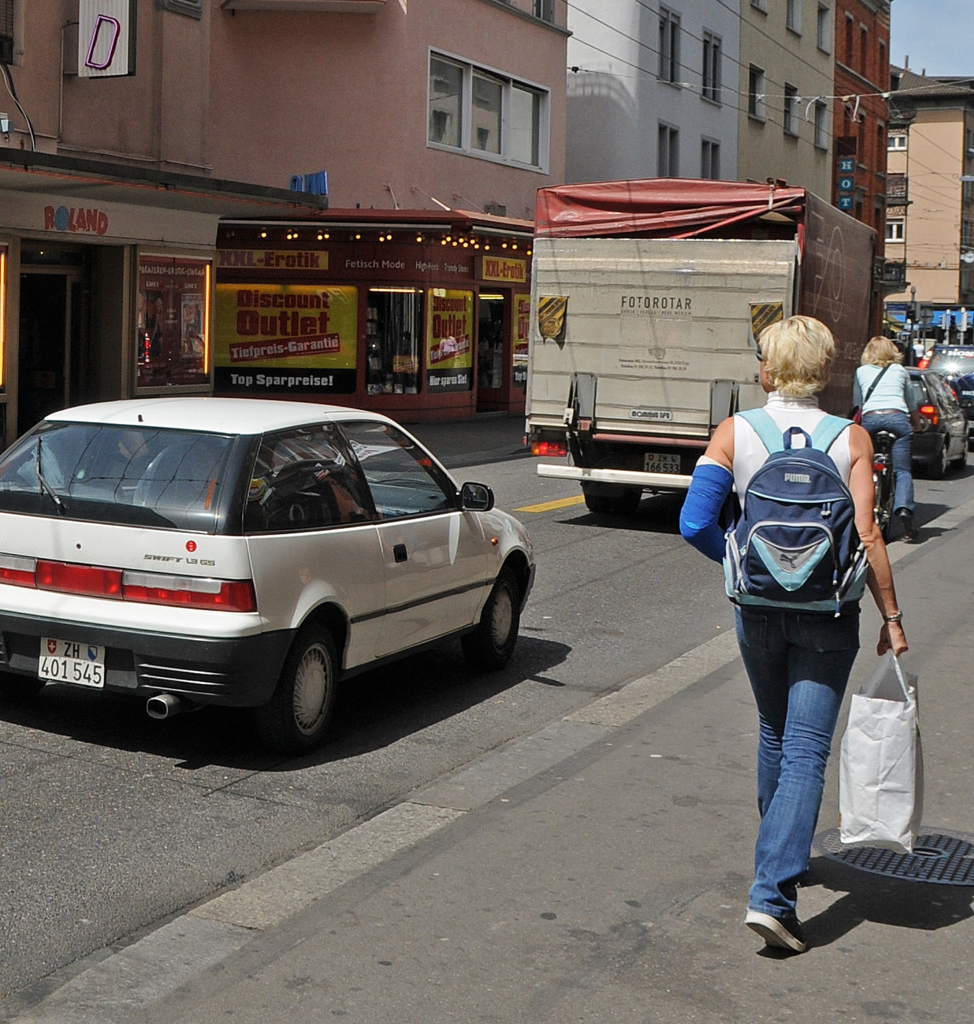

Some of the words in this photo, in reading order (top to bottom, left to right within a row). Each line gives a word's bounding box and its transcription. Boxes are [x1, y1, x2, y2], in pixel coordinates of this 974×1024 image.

[44, 205, 109, 236] ROLAND
[219, 250, 320, 268] XXL-Erotik
[345, 259, 379, 268] Fetisch
[381, 261, 406, 269] Mode
[485, 259, 524, 279] XXL-Erotik
[237, 290, 330, 309] Discount
[621, 296, 692, 310] FOTOROTAR
[236, 310, 330, 336] Outlet
[433, 313, 467, 339] Outlet
[231, 336, 339, 358] Tiefpreis-Garantie
[231, 374, 253, 386] Top
[256, 374, 334, 387] Sparpreise!
[645, 462, 661, 472] 166
[663, 463, 679, 473] 533
[144, 554, 183, 563] SWIFT
[63, 641, 80, 657] ZH
[41, 656, 68, 679] 401
[75, 662, 103, 685] 545
